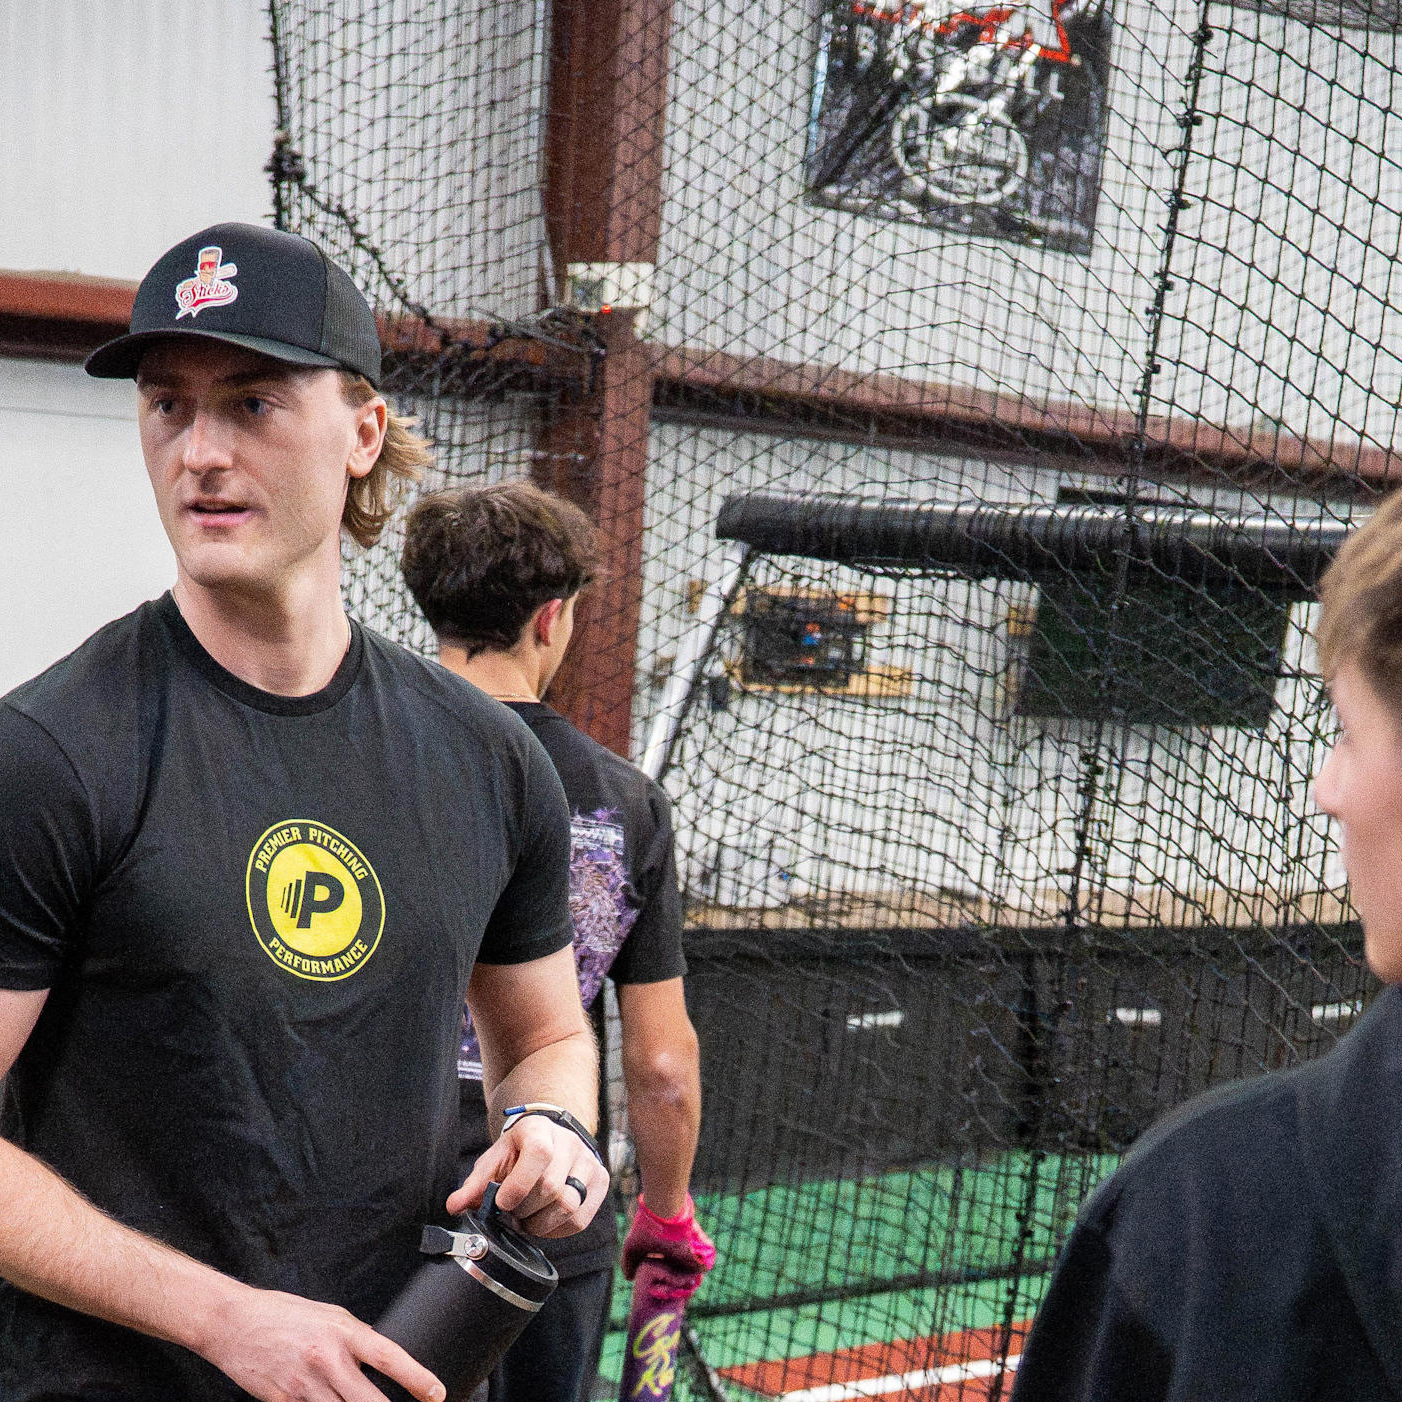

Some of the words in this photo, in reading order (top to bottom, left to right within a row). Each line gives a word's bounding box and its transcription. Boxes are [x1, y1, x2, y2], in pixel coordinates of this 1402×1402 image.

[254, 826, 302, 873] PREMIER
[308, 827, 368, 881] PITCHING
[269, 937, 368, 975] PERFORMANCE
